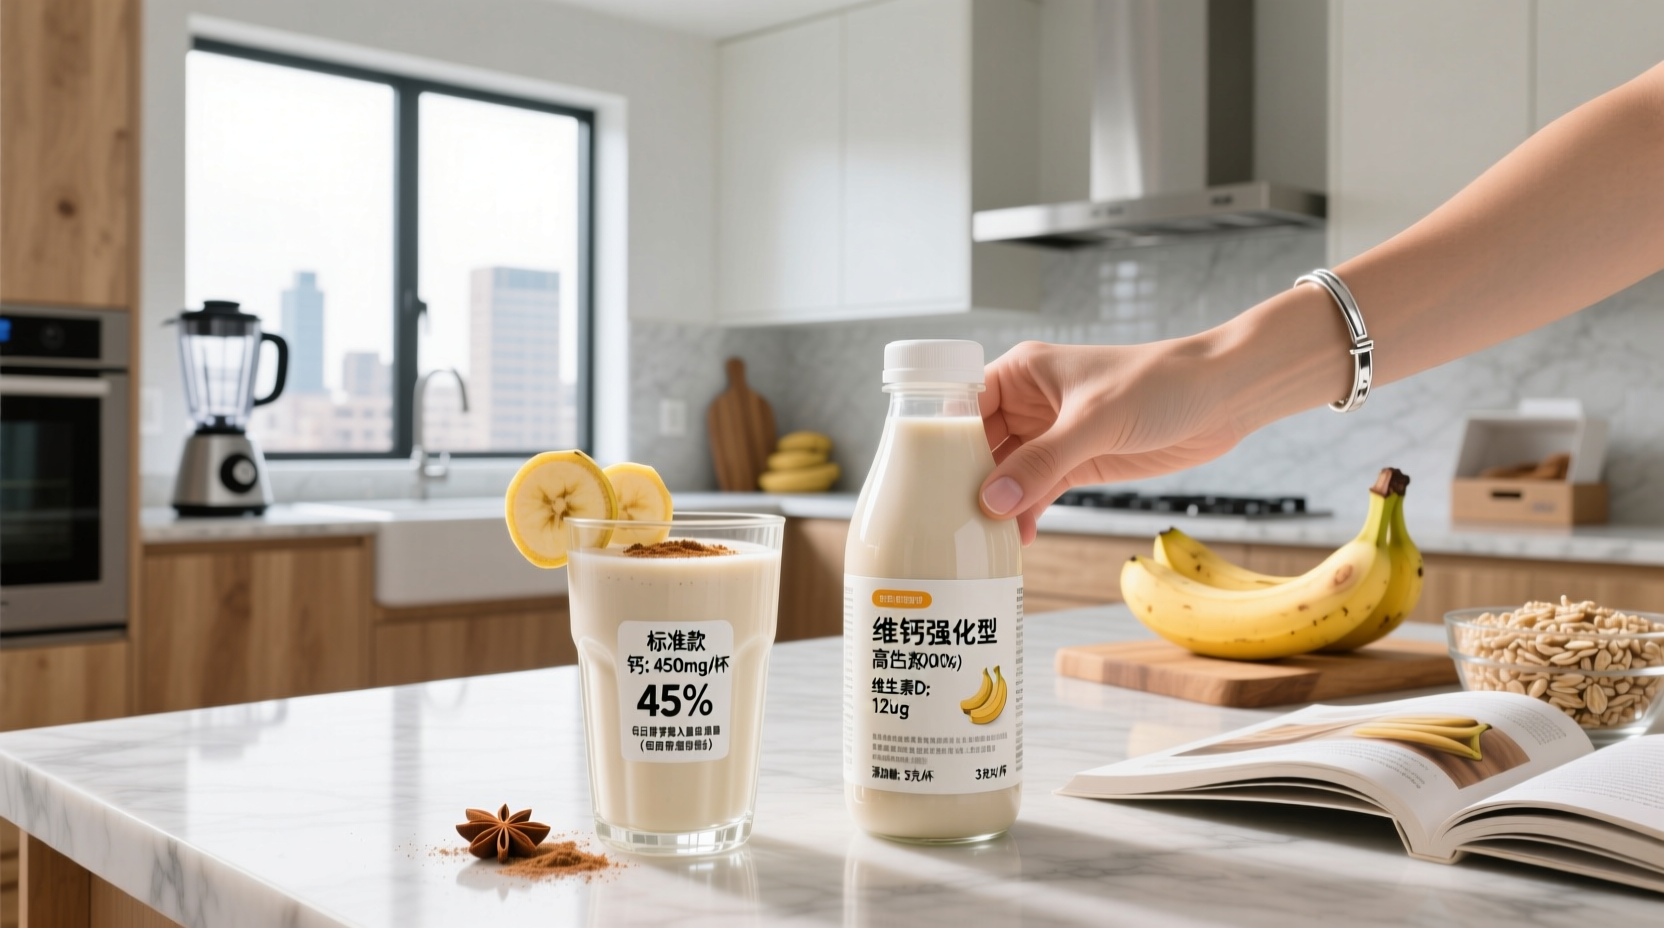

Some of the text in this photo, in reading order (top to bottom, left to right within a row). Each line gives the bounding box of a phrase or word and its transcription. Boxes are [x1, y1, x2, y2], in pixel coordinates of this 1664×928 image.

[646, 629, 706, 652] 标准款
[872, 616, 998, 646] 维钙强化型
[636, 683, 713, 717] 45%
